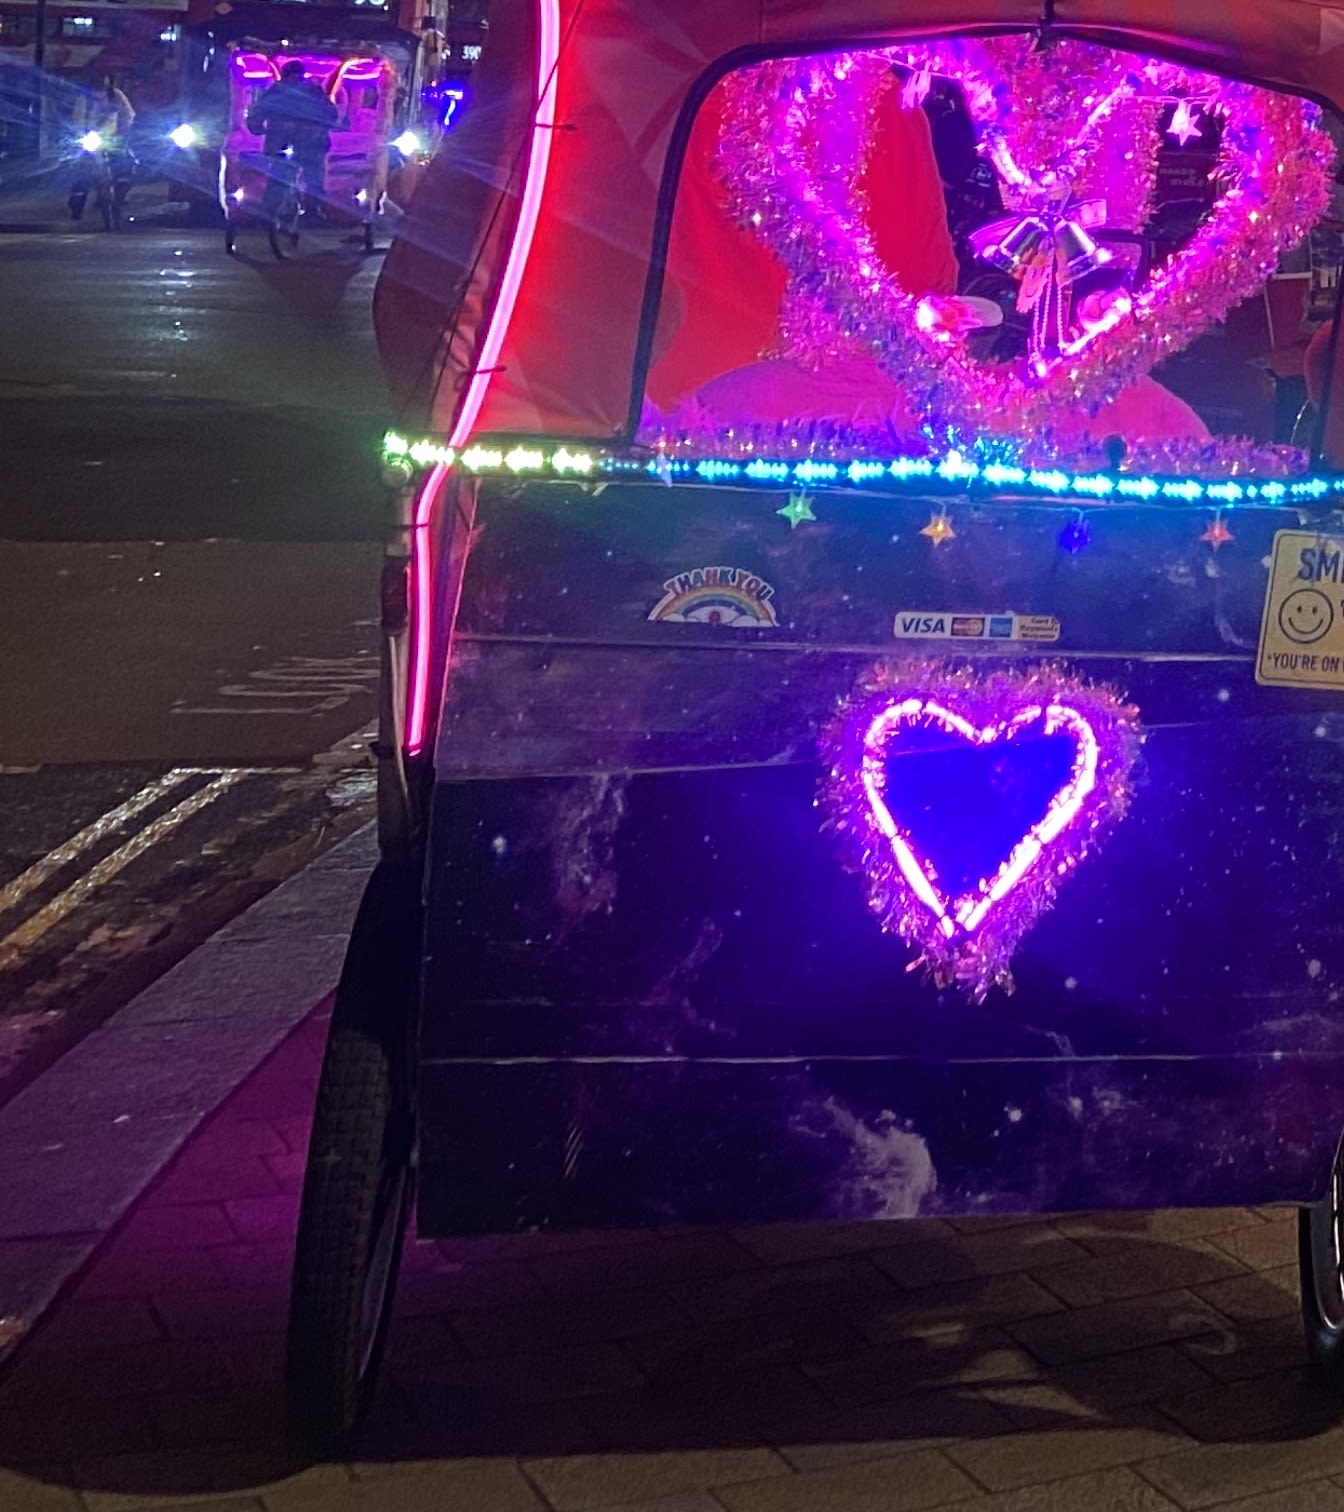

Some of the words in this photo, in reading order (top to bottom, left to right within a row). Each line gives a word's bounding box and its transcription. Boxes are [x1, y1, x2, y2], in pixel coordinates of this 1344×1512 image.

[663, 567, 735, 594] THANK
[735, 568, 776, 601] YOU
[902, 617, 946, 634] VISA
[1272, 651, 1317, 672] YOU'RE
[1321, 655, 1340, 674] ON
